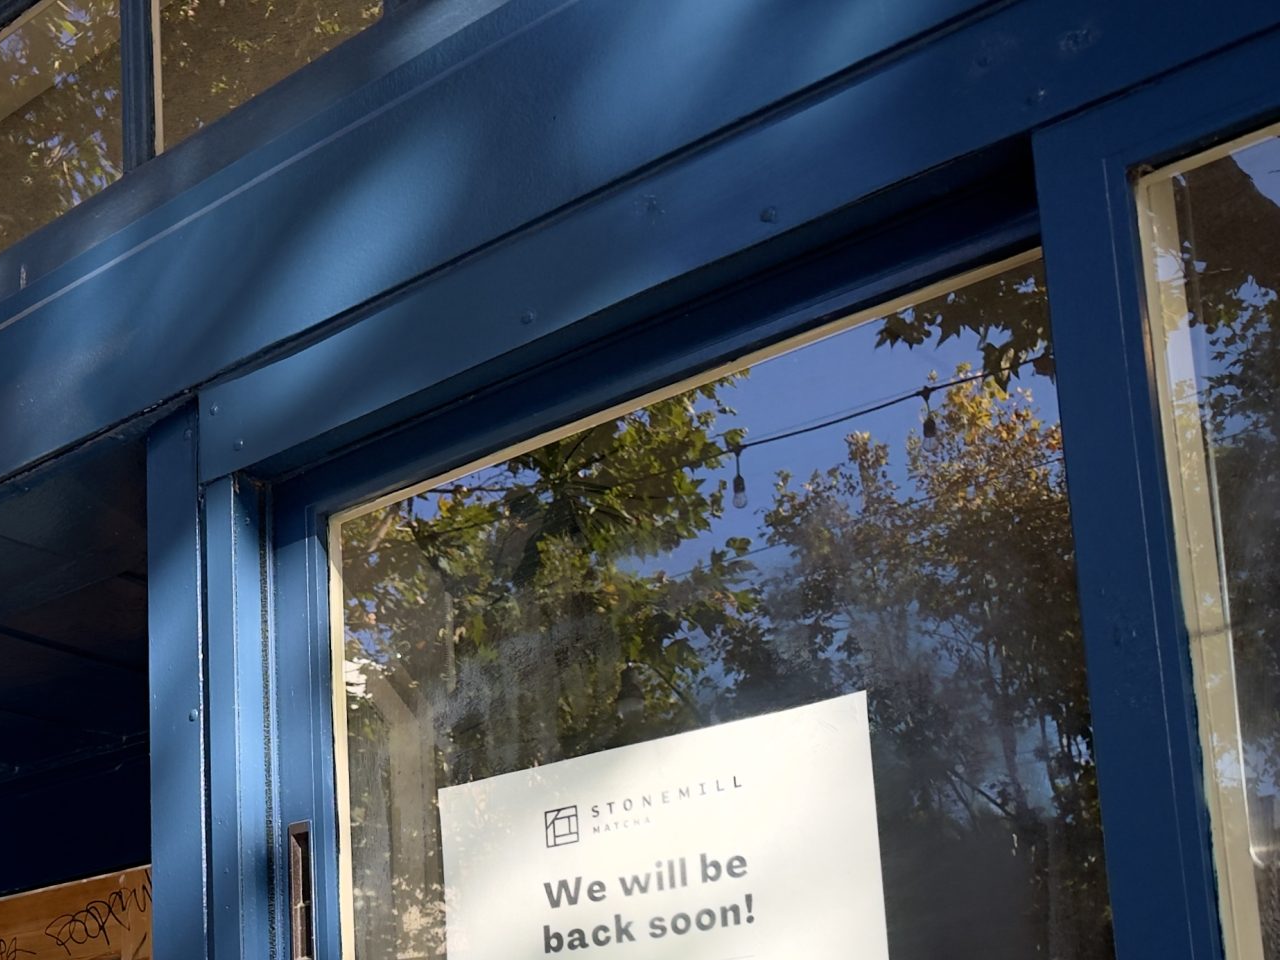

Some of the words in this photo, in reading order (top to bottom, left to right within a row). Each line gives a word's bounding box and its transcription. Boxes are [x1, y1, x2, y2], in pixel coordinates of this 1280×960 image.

[591, 775, 742, 818] STONEMILL
[592, 816, 651, 834] MATCHA
[543, 876, 607, 909] We
[618, 857, 688, 897] will
[699, 853, 748, 883] be
[543, 913, 636, 954] back
[648, 893, 755, 939] soon!
